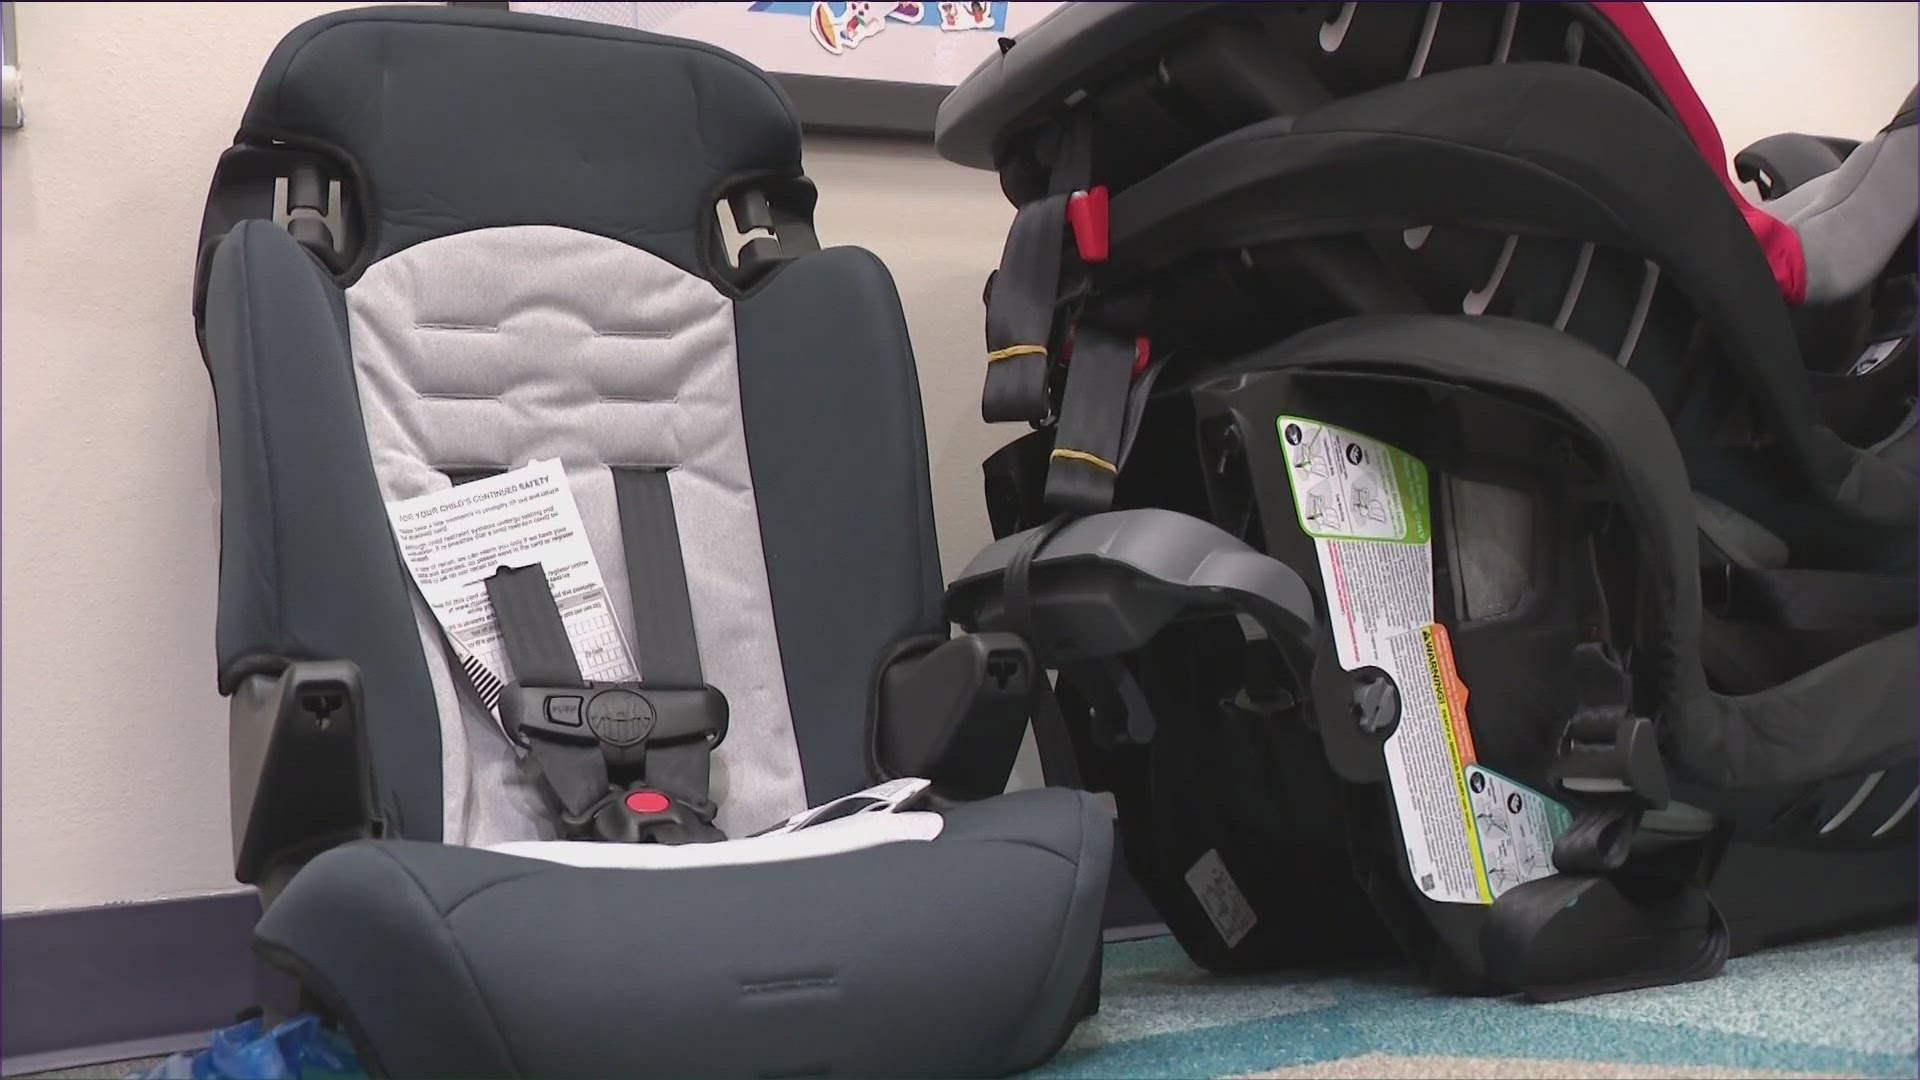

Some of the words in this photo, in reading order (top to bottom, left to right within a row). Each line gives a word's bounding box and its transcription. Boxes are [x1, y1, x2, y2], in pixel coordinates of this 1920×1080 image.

[415, 507, 438, 519] YOUR
[440, 498, 472, 512] CHILD'S
[473, 485, 518, 502] CONTINUED
[519, 475, 549, 490] SAFETY
[1424, 640, 1445, 704] WARNING!
